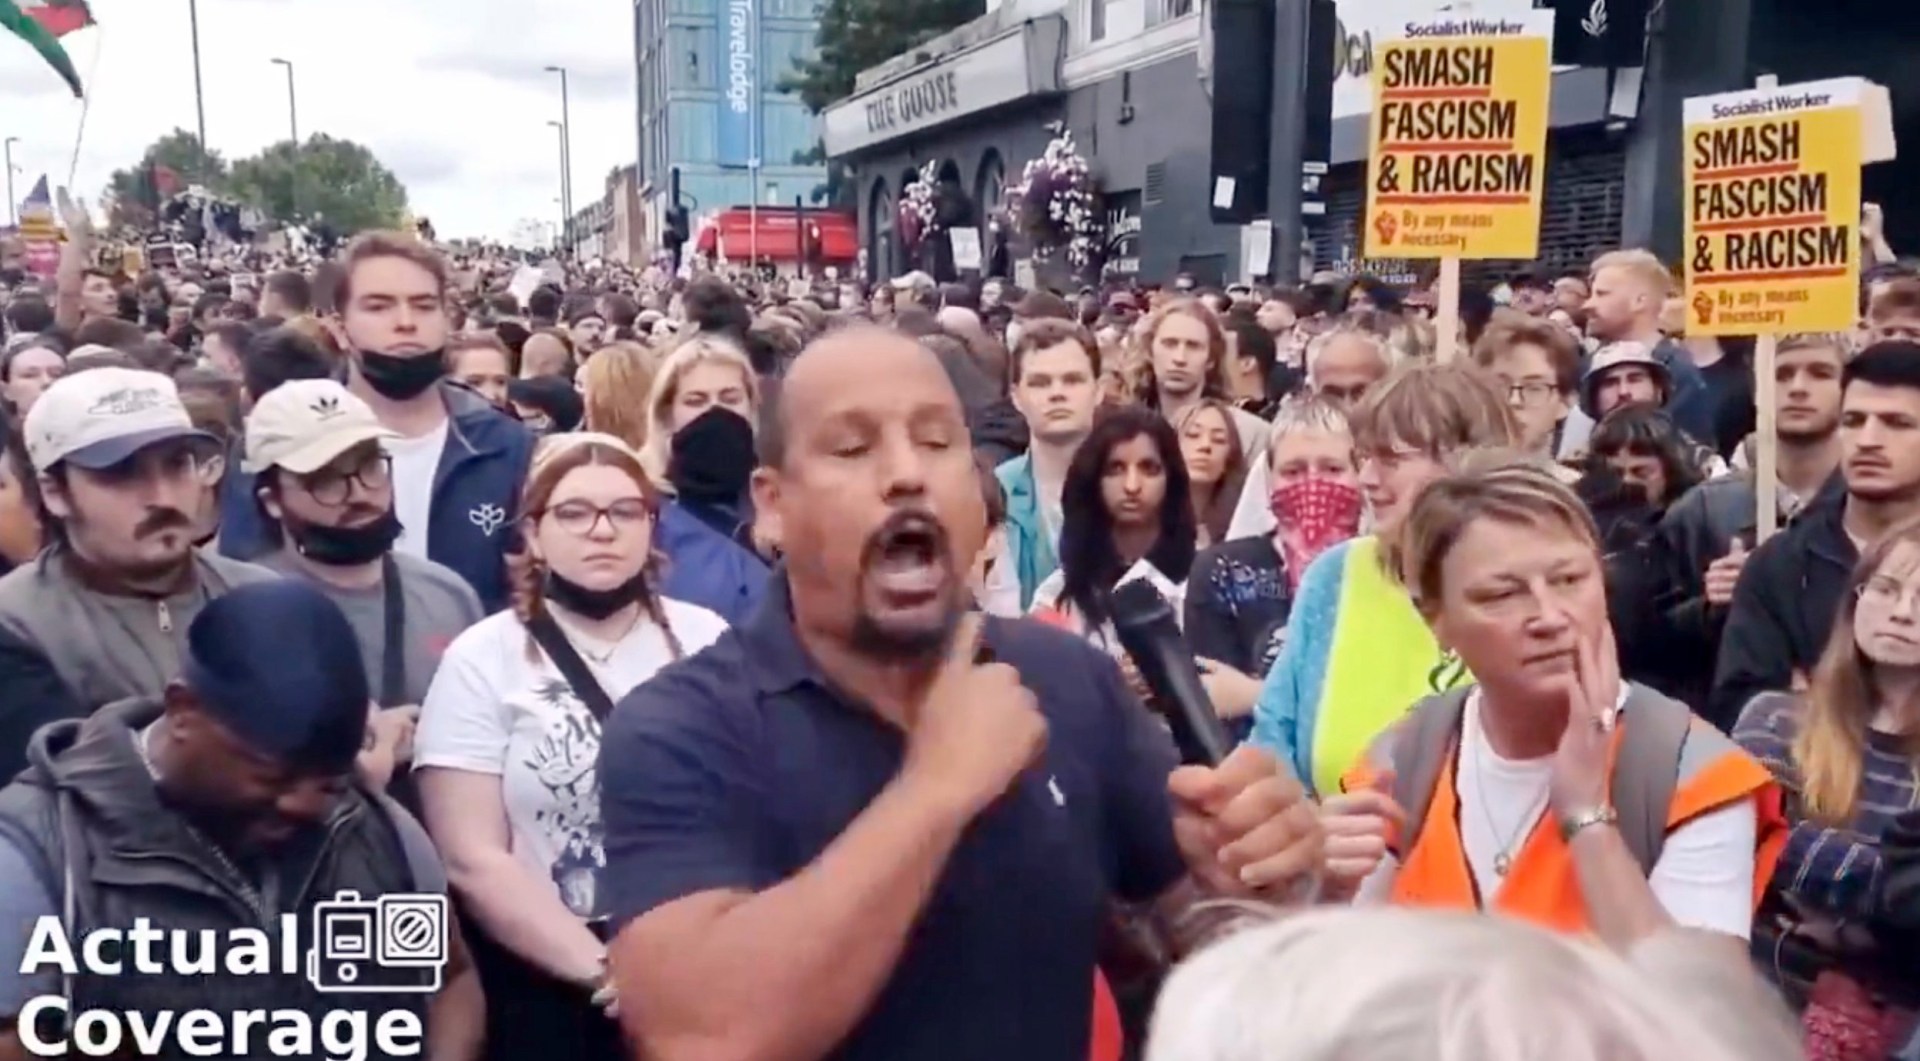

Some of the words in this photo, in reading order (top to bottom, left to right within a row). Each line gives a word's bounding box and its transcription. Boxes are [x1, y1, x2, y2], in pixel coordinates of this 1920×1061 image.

[1404, 21, 1467, 38] Socialist
[1469, 18, 1524, 34] Worker
[726, 0, 753, 113] Travelodge
[1383, 46, 1494, 87] SMASH
[866, 95, 896, 133] THE
[1379, 100, 1517, 142] FASCISM
[1712, 98, 1773, 119] Socialist
[1775, 92, 1832, 110] Worker
[1693, 119, 1800, 170] SMASH
[1376, 154, 1399, 193] &
[1411, 153, 1534, 193] RACISM
[1693, 172, 1827, 222] FASCISM
[1402, 209, 1420, 231] By
[1423, 214, 1446, 233] any
[1692, 234, 1714, 273] &
[1724, 225, 1849, 271] RACISM
[1718, 289, 1734, 309] By
